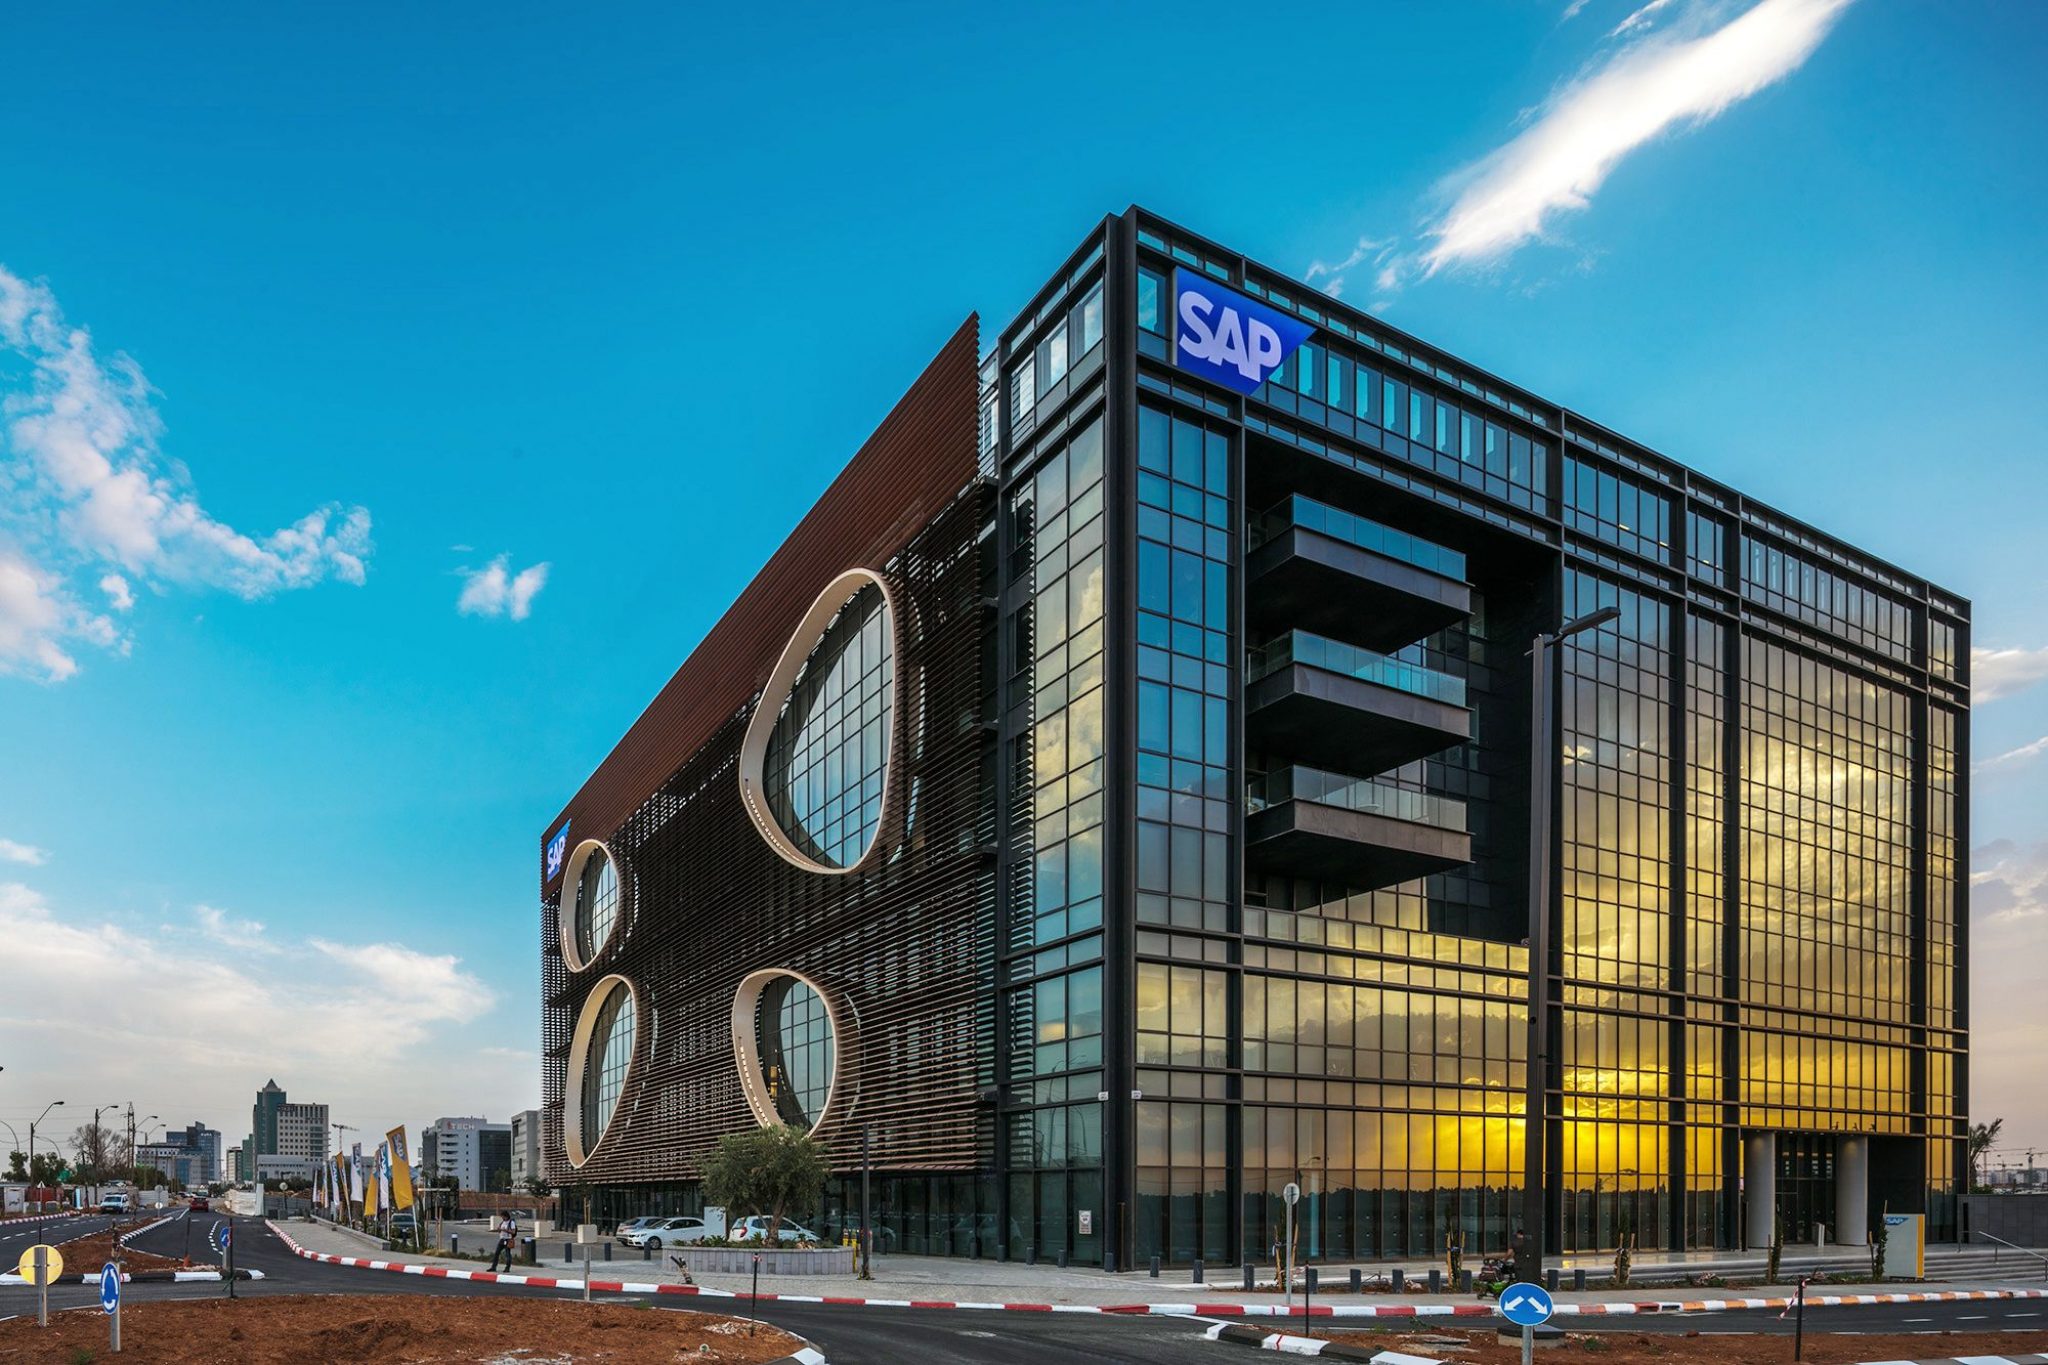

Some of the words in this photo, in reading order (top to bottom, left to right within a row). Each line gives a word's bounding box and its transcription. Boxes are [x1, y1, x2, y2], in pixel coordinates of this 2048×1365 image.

[1179, 291, 1282, 382] SAP
[547, 836, 566, 874] SAP
[394, 1133, 404, 1158] SAP
